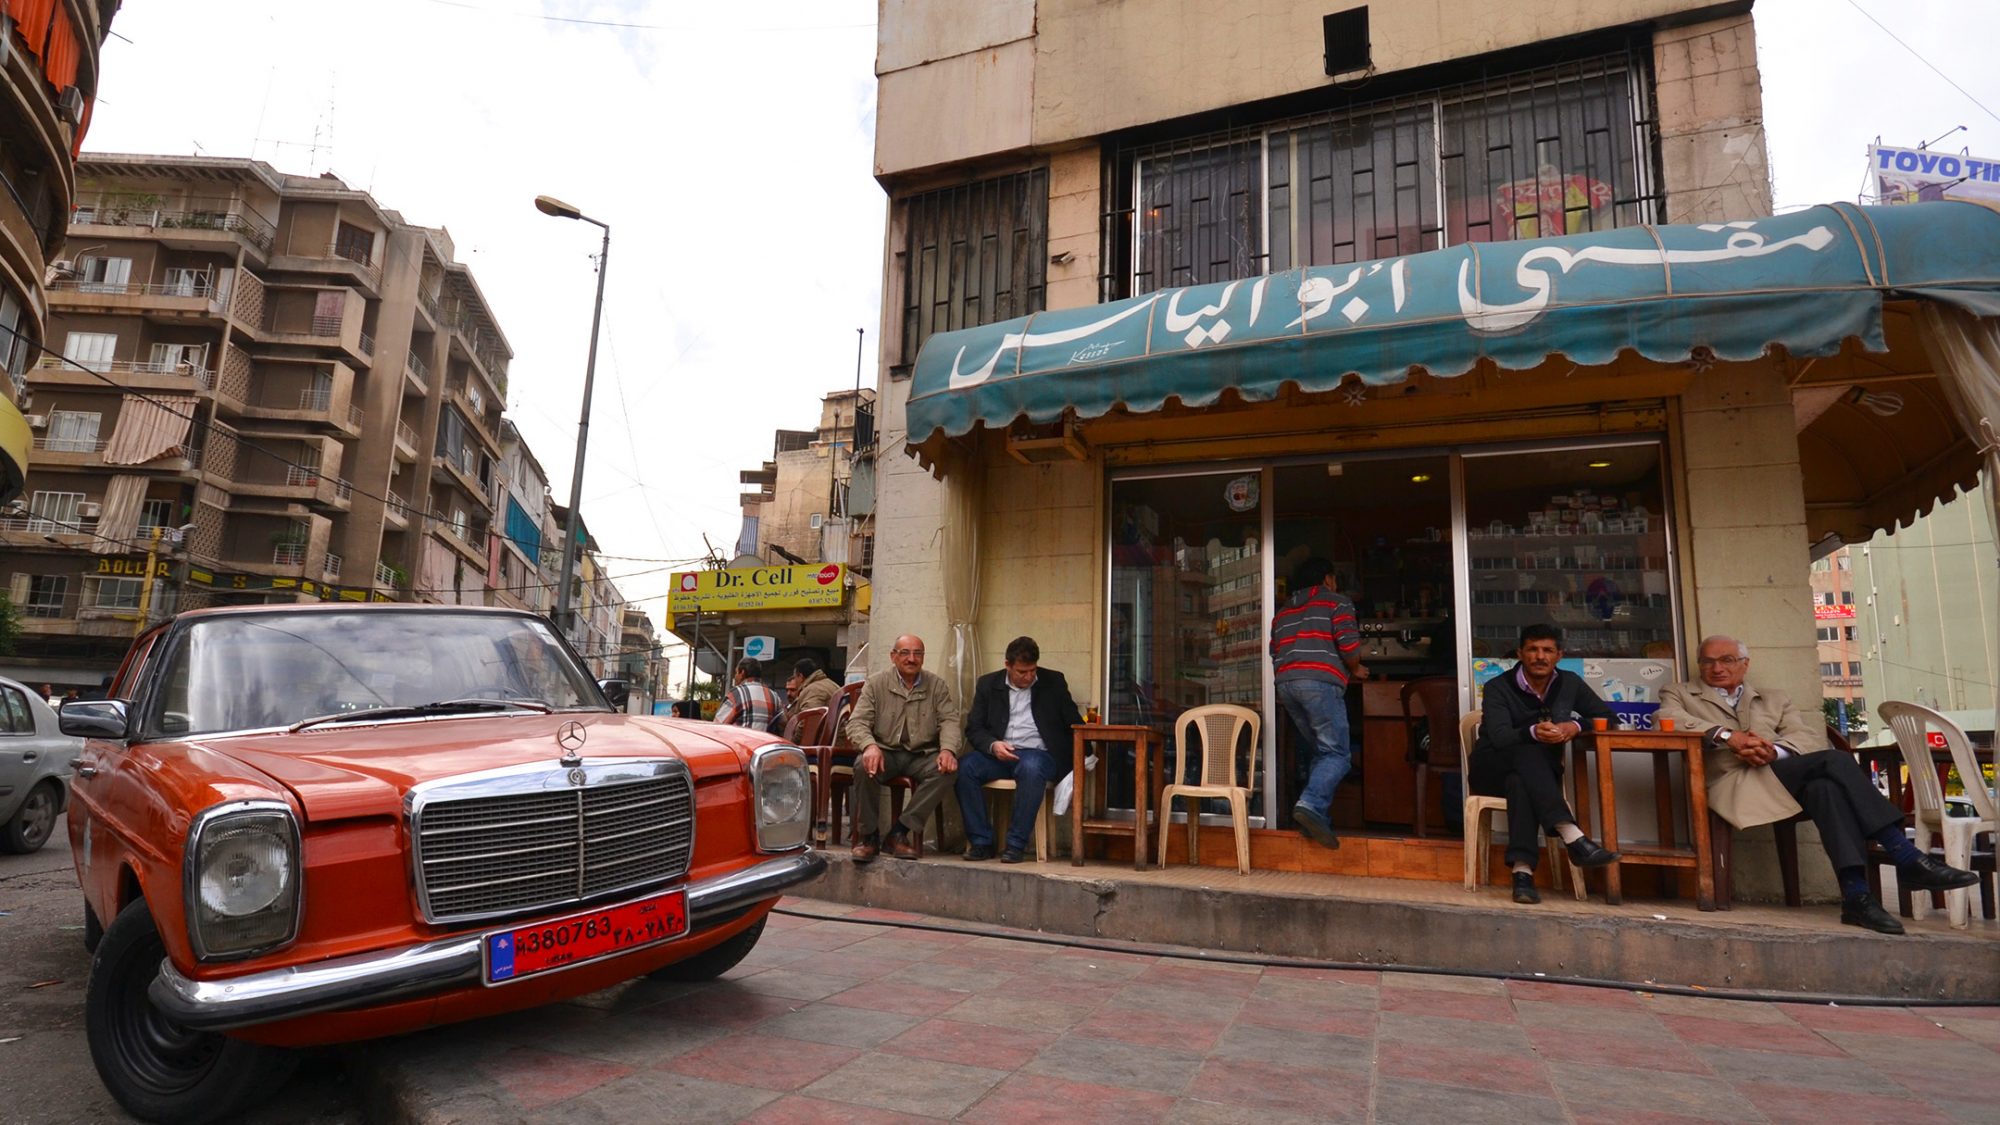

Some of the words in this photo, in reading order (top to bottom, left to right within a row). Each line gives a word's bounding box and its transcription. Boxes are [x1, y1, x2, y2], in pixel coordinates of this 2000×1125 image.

[1877, 149, 1961, 177] TOYO
[97, 559, 171, 577] DOLLR
[715, 571, 744, 587] Dr.
[752, 567, 792, 586] Cell
